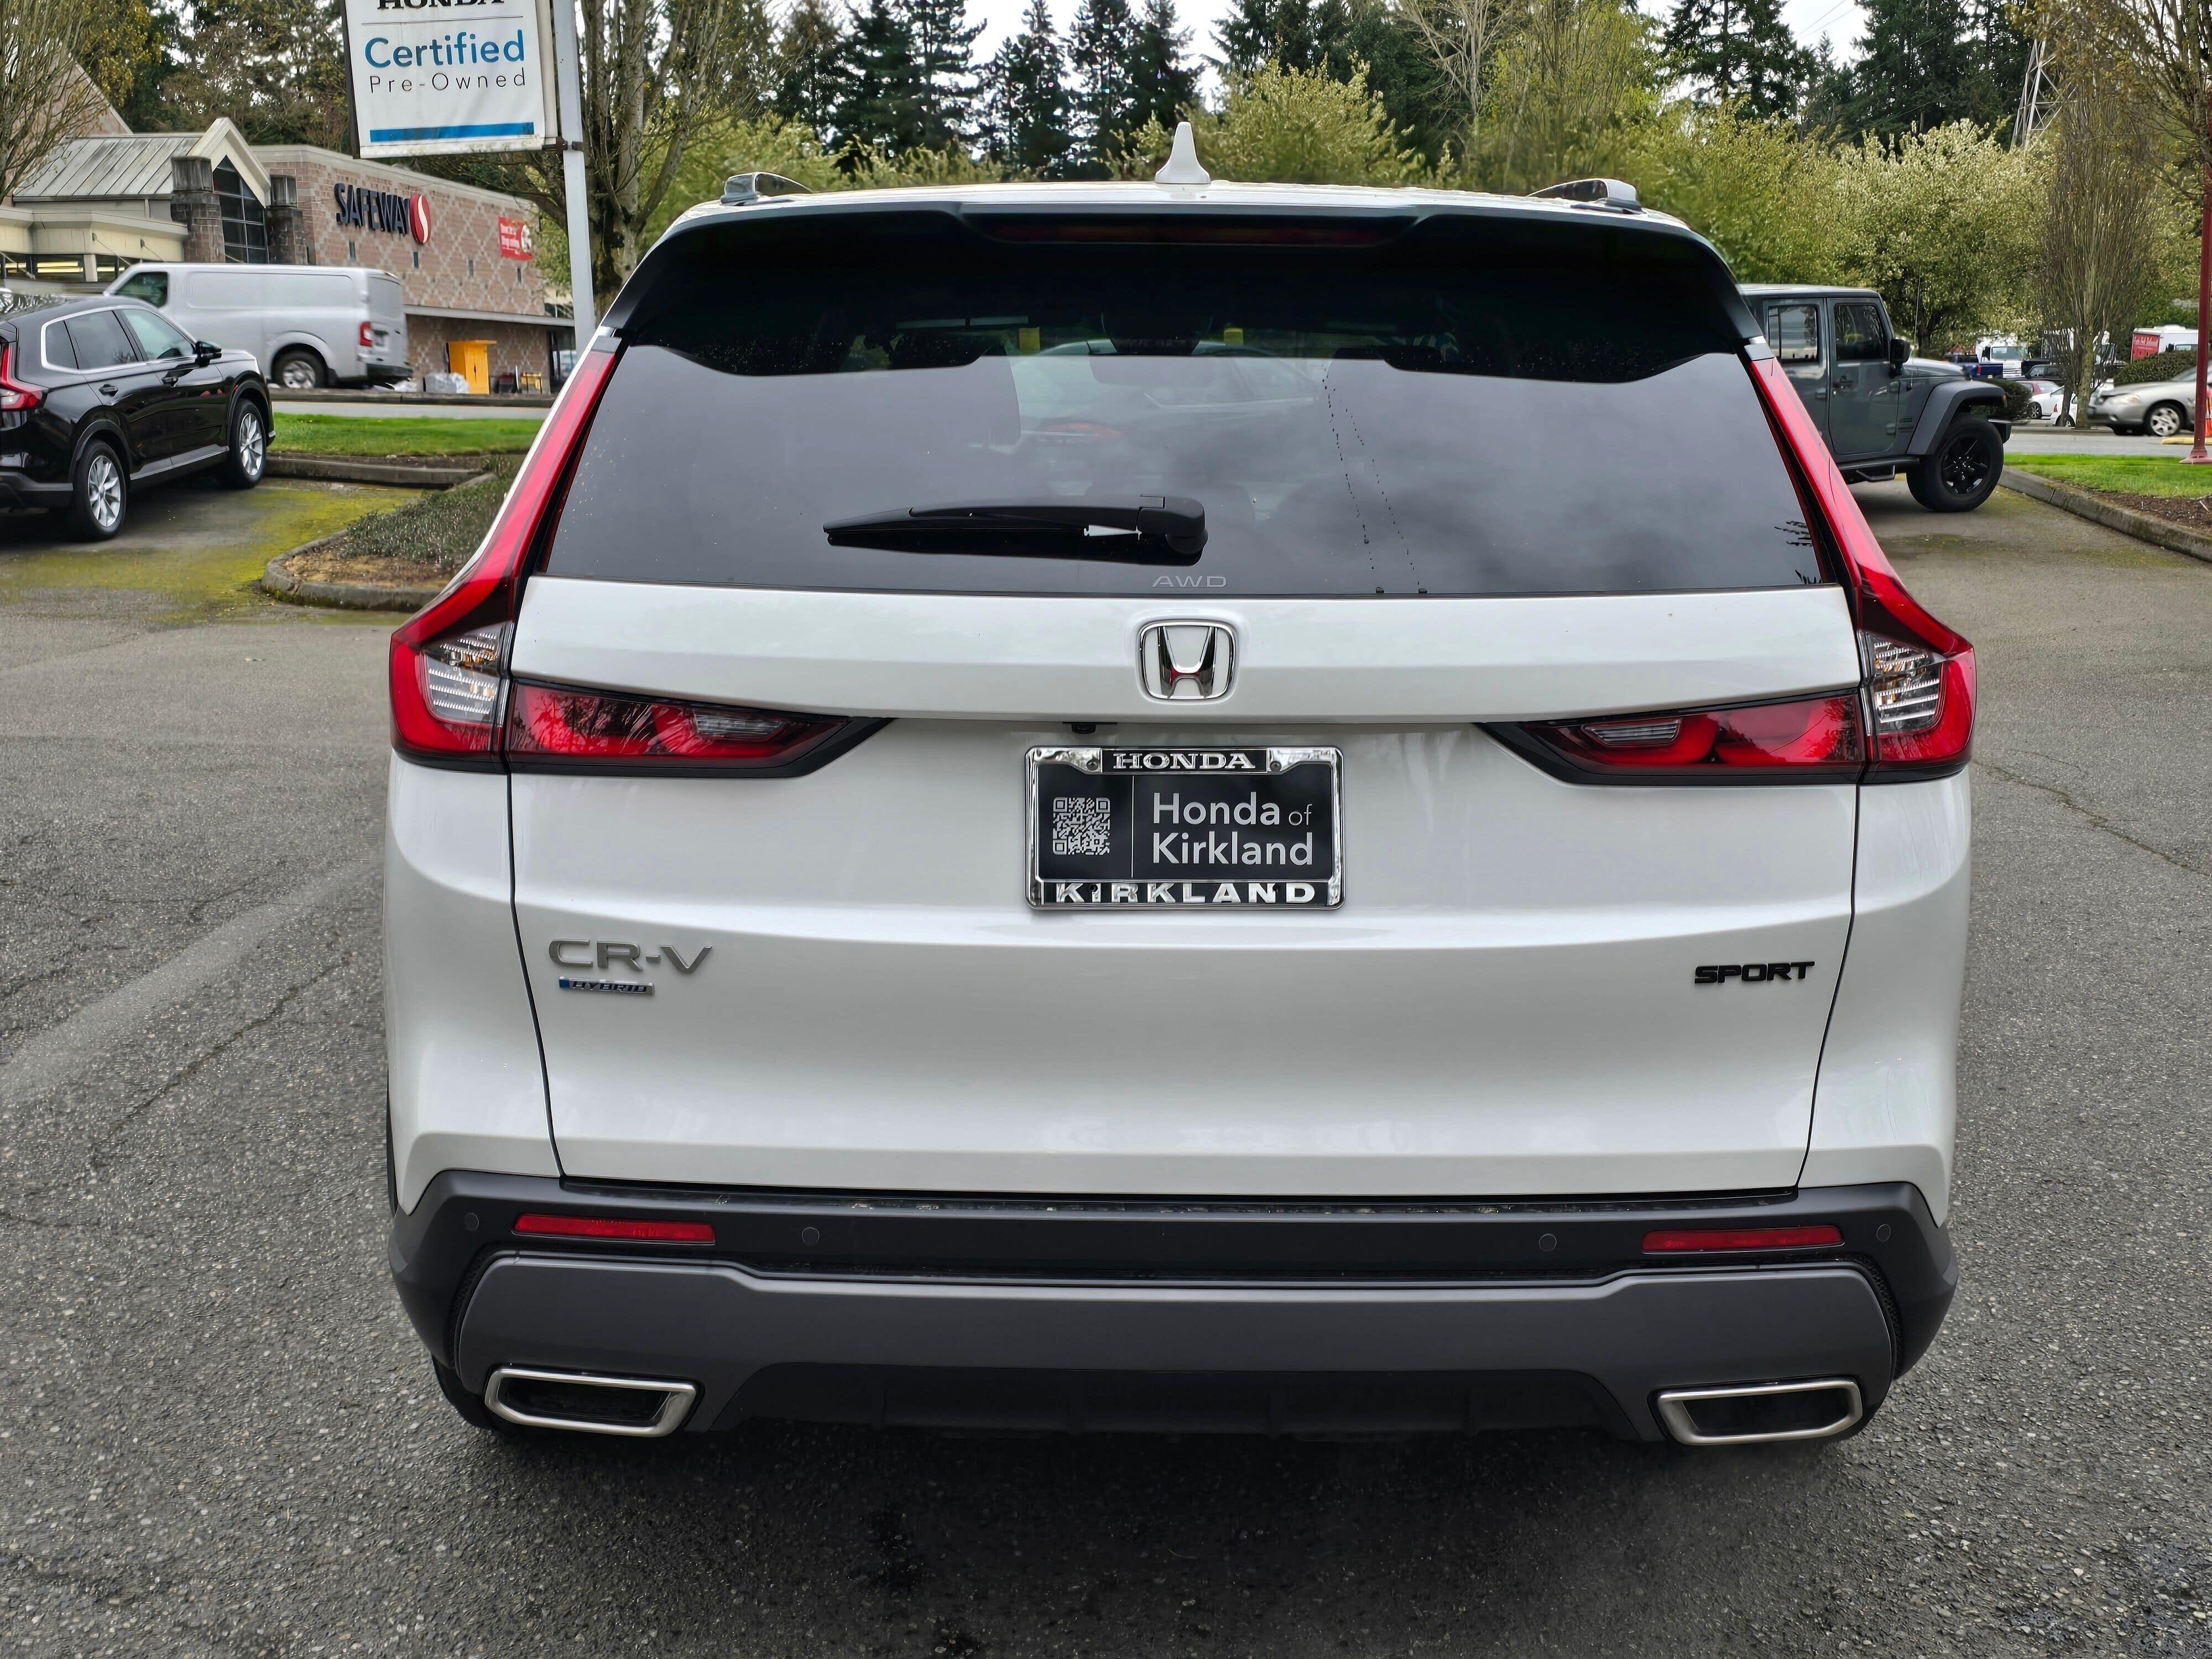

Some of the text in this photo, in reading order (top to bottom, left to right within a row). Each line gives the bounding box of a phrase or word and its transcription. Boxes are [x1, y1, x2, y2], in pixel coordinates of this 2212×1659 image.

[365, 29, 524, 68] Certified
[370, 67, 525, 93] Pre-Owned
[334, 182, 411, 235] SAFEWAY
[1152, 576, 1227, 587] AWD
[1113, 753, 1256, 769] HONDA
[1154, 791, 1312, 826] Honda of
[1153, 832, 1312, 865] Kirkland
[1056, 882, 1316, 904] KIRKLAND
[549, 939, 712, 973] CR-V
[1695, 961, 1815, 983] SPORT
[572, 980, 648, 994] HYBRID
